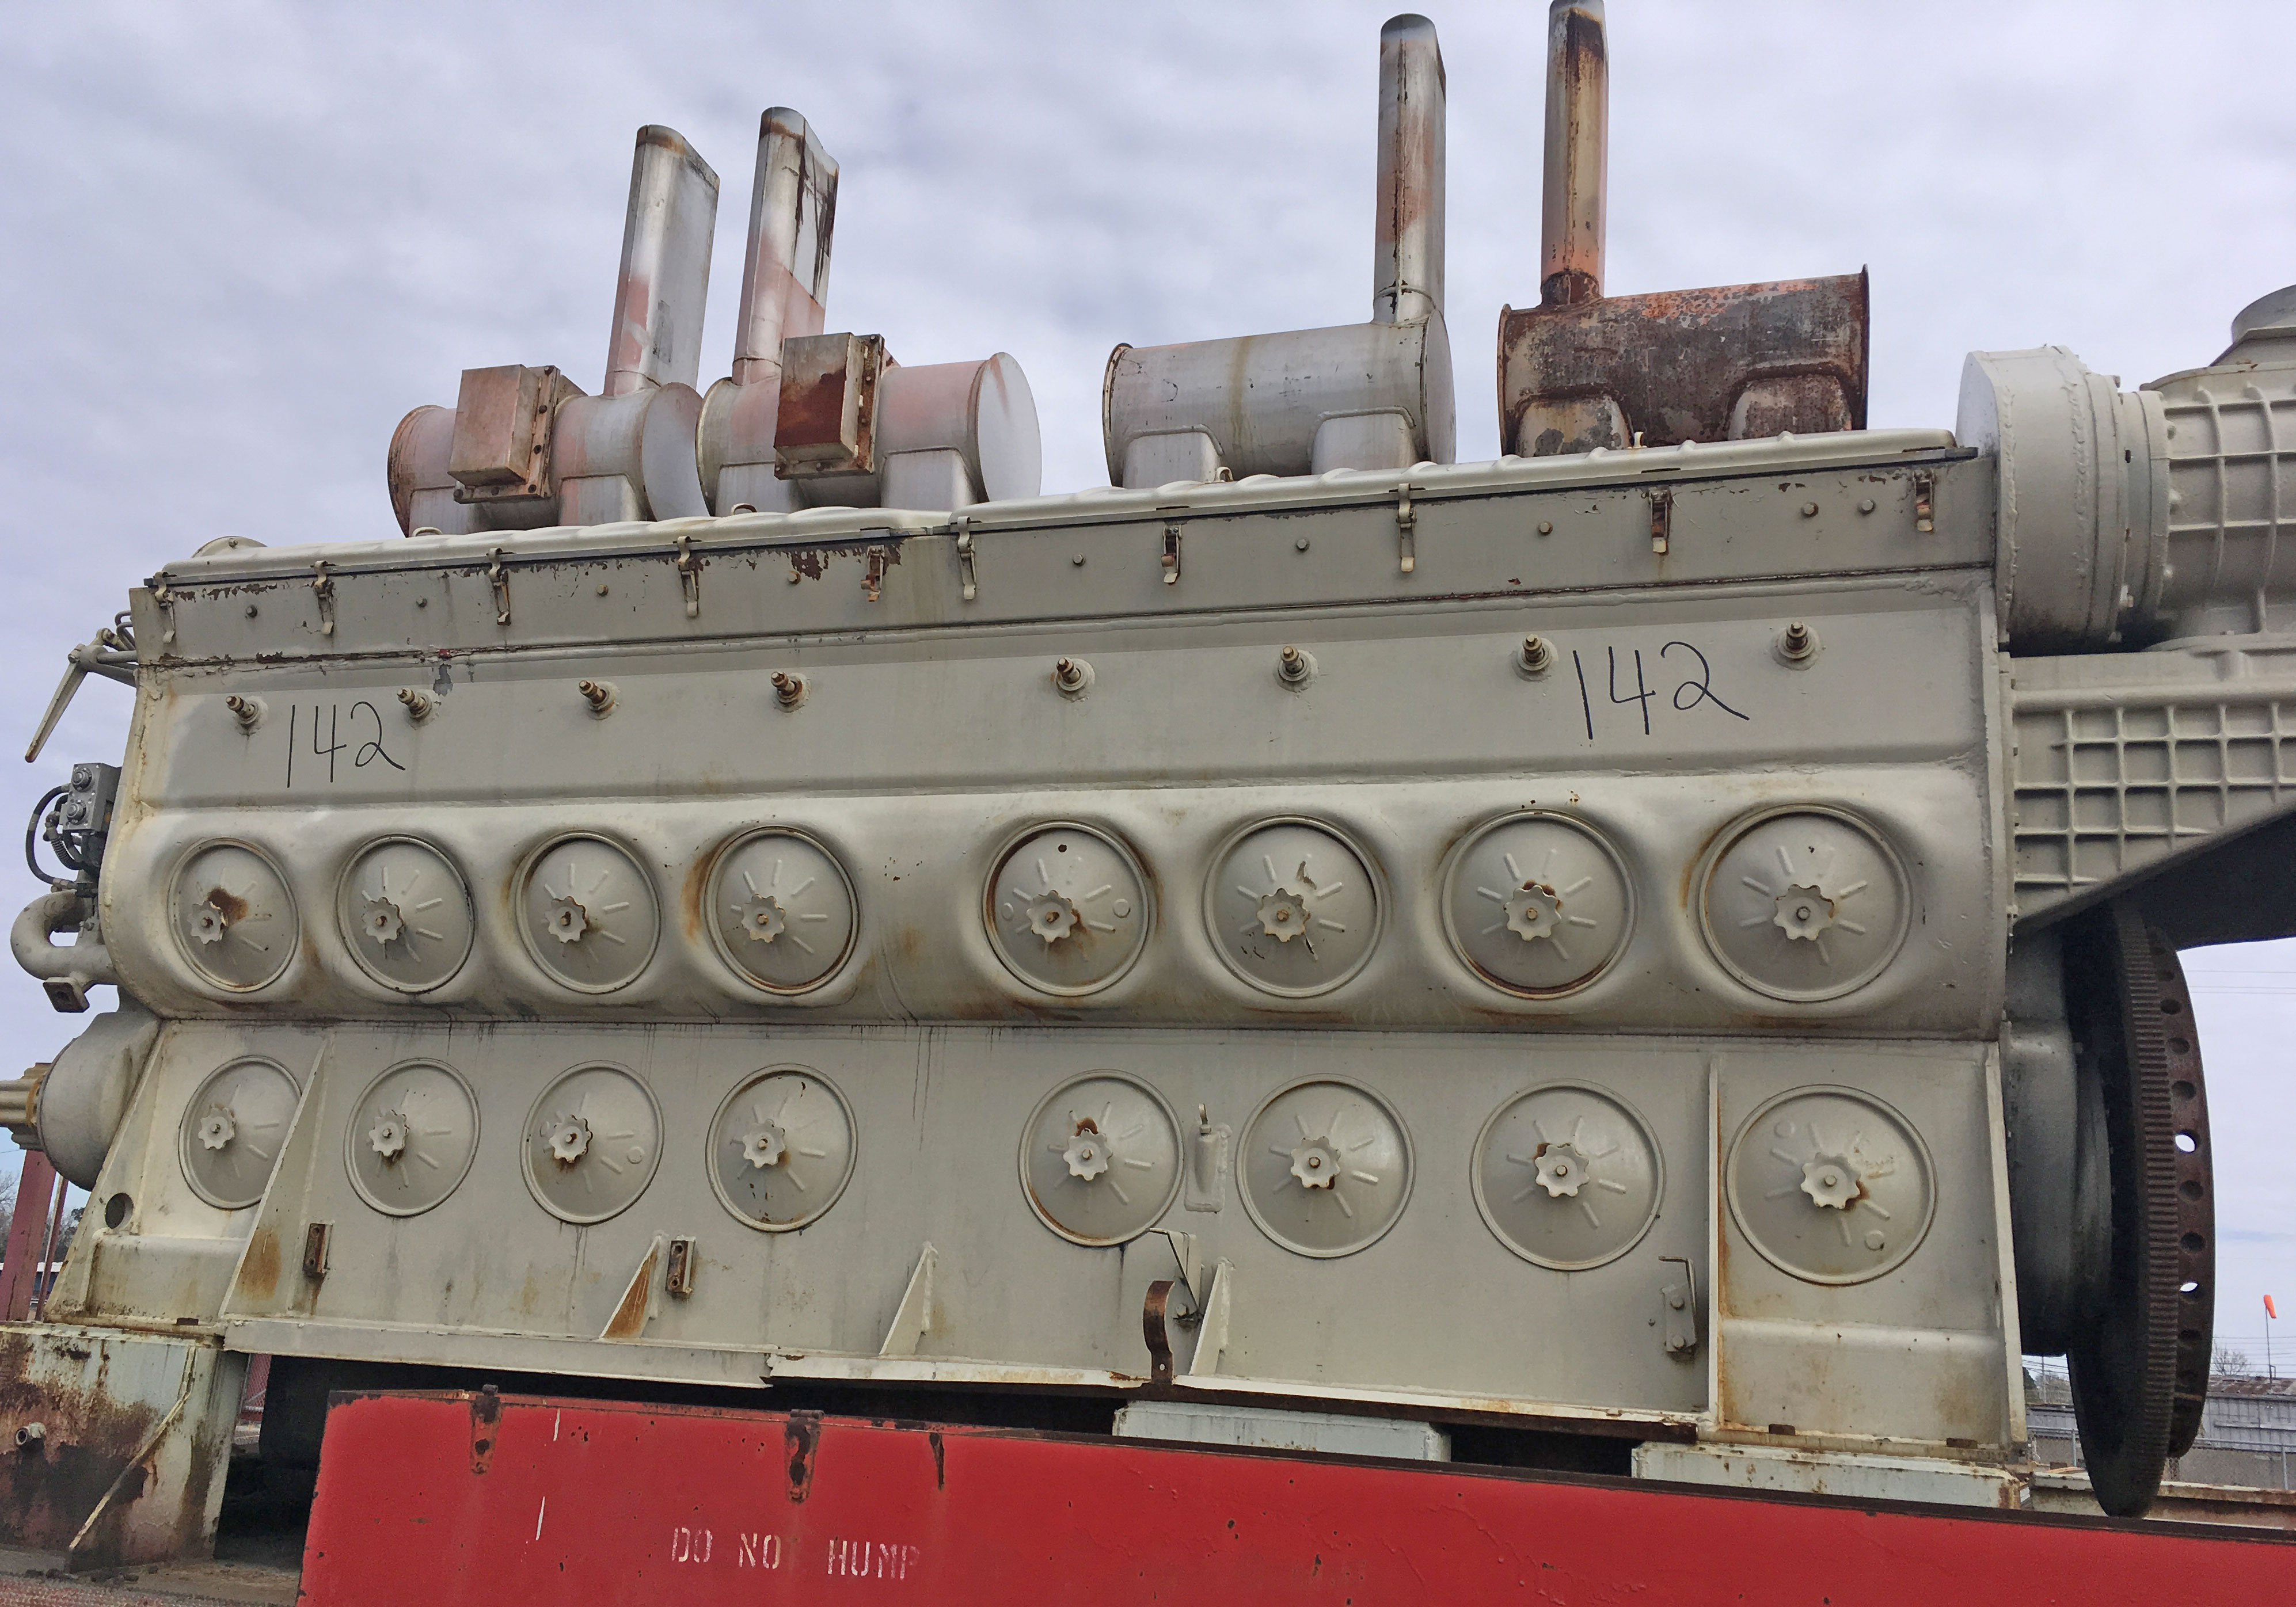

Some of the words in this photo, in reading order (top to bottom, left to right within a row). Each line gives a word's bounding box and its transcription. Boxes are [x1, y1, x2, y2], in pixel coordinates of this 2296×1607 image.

[1572, 641, 1750, 740] 142
[287, 700, 406, 789] 142
[671, 1527, 713, 1563] DO
[827, 1540, 920, 1581] HUMP
